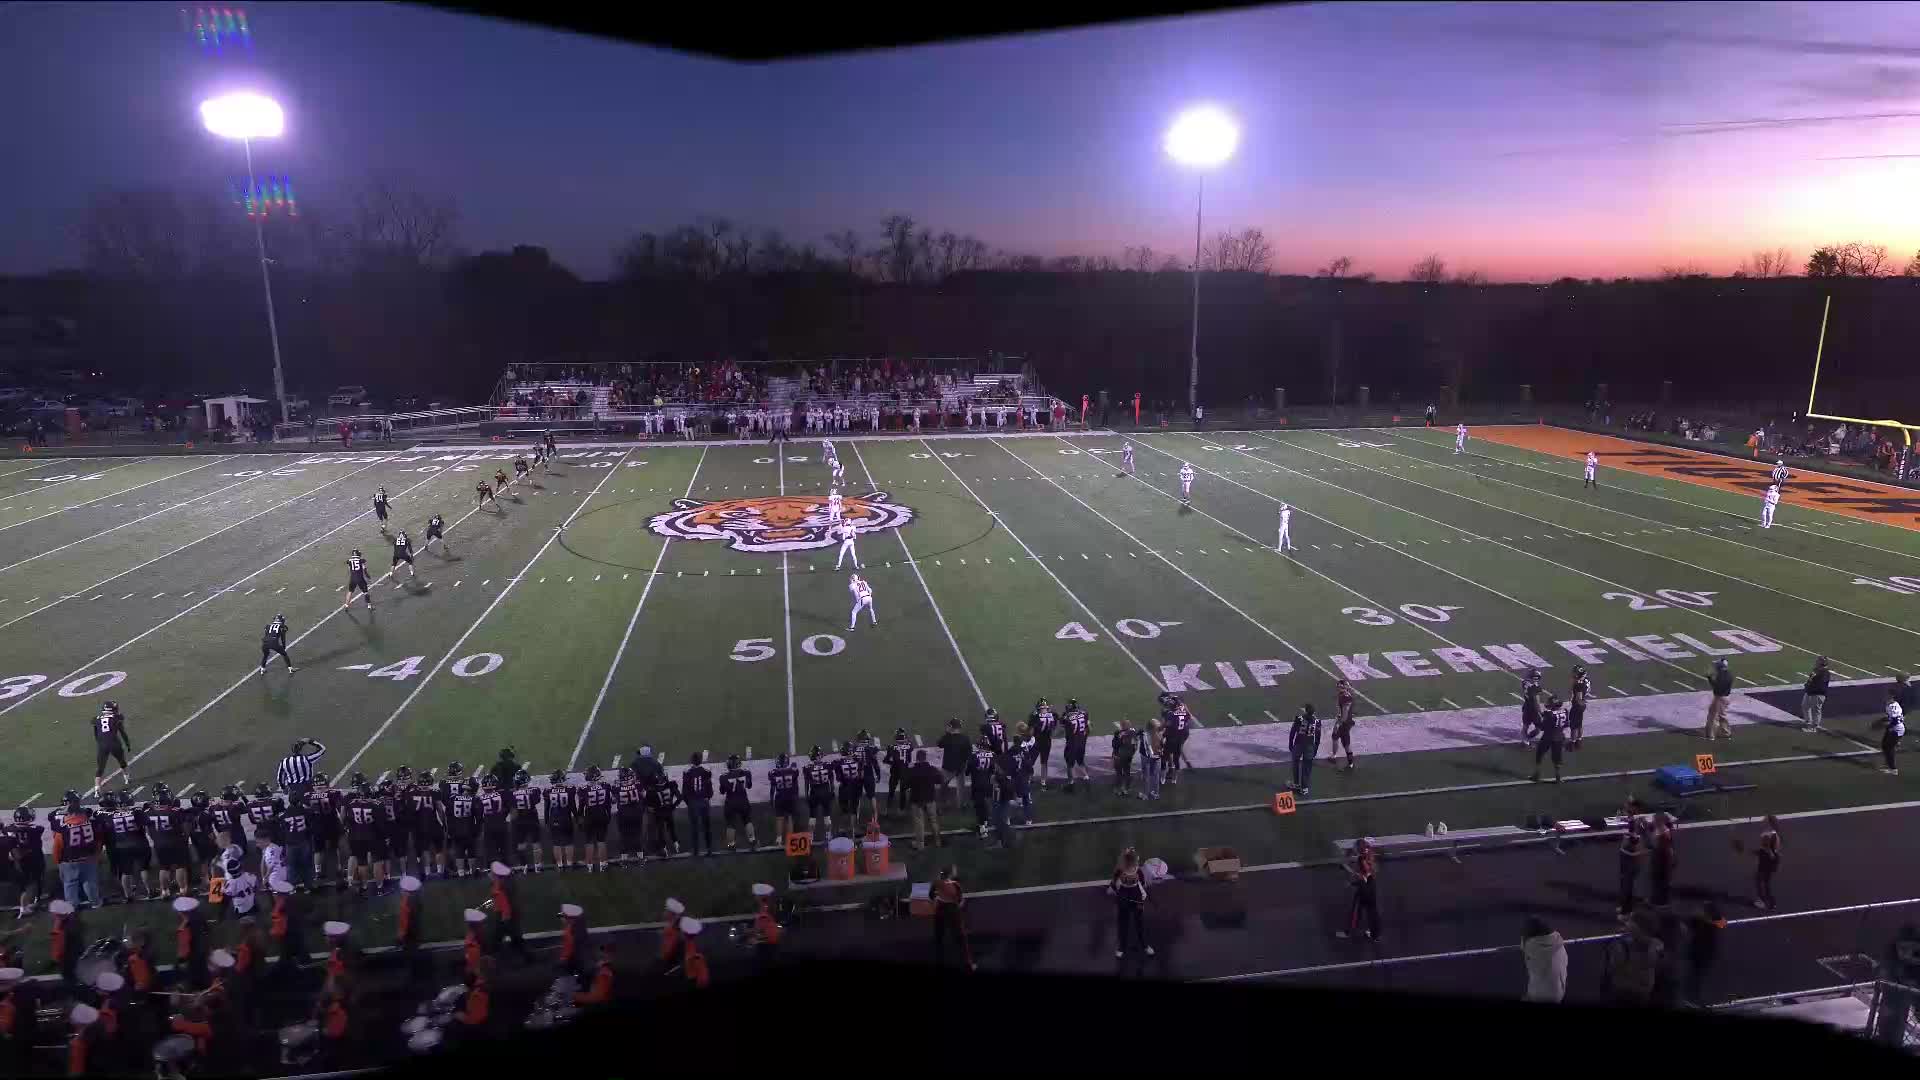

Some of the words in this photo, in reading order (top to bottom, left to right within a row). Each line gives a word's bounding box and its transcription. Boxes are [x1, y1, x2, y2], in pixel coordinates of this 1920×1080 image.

[351, 560, 361, 571] 15
[1602, 589, 1714, 610] 20
[1341, 603, 1452, 626] 30
[1055, 618, 1161, 642] 40
[728, 634, 847, 662] 50
[367, 652, 504, 681] 40
[1160, 659, 1295, 692] KIP
[1328, 643, 1553, 681] KERN
[1554, 629, 1784, 664] FIELD
[0, 671, 127, 700] 30
[101, 718, 110, 733] 8
[1699, 757, 1714, 770] 30
[413, 795, 434, 812] 74
[453, 800, 473, 818] 68
[1278, 796, 1293, 810] 40
[69, 823, 95, 847] 69
[789, 837, 808, 852] 50
